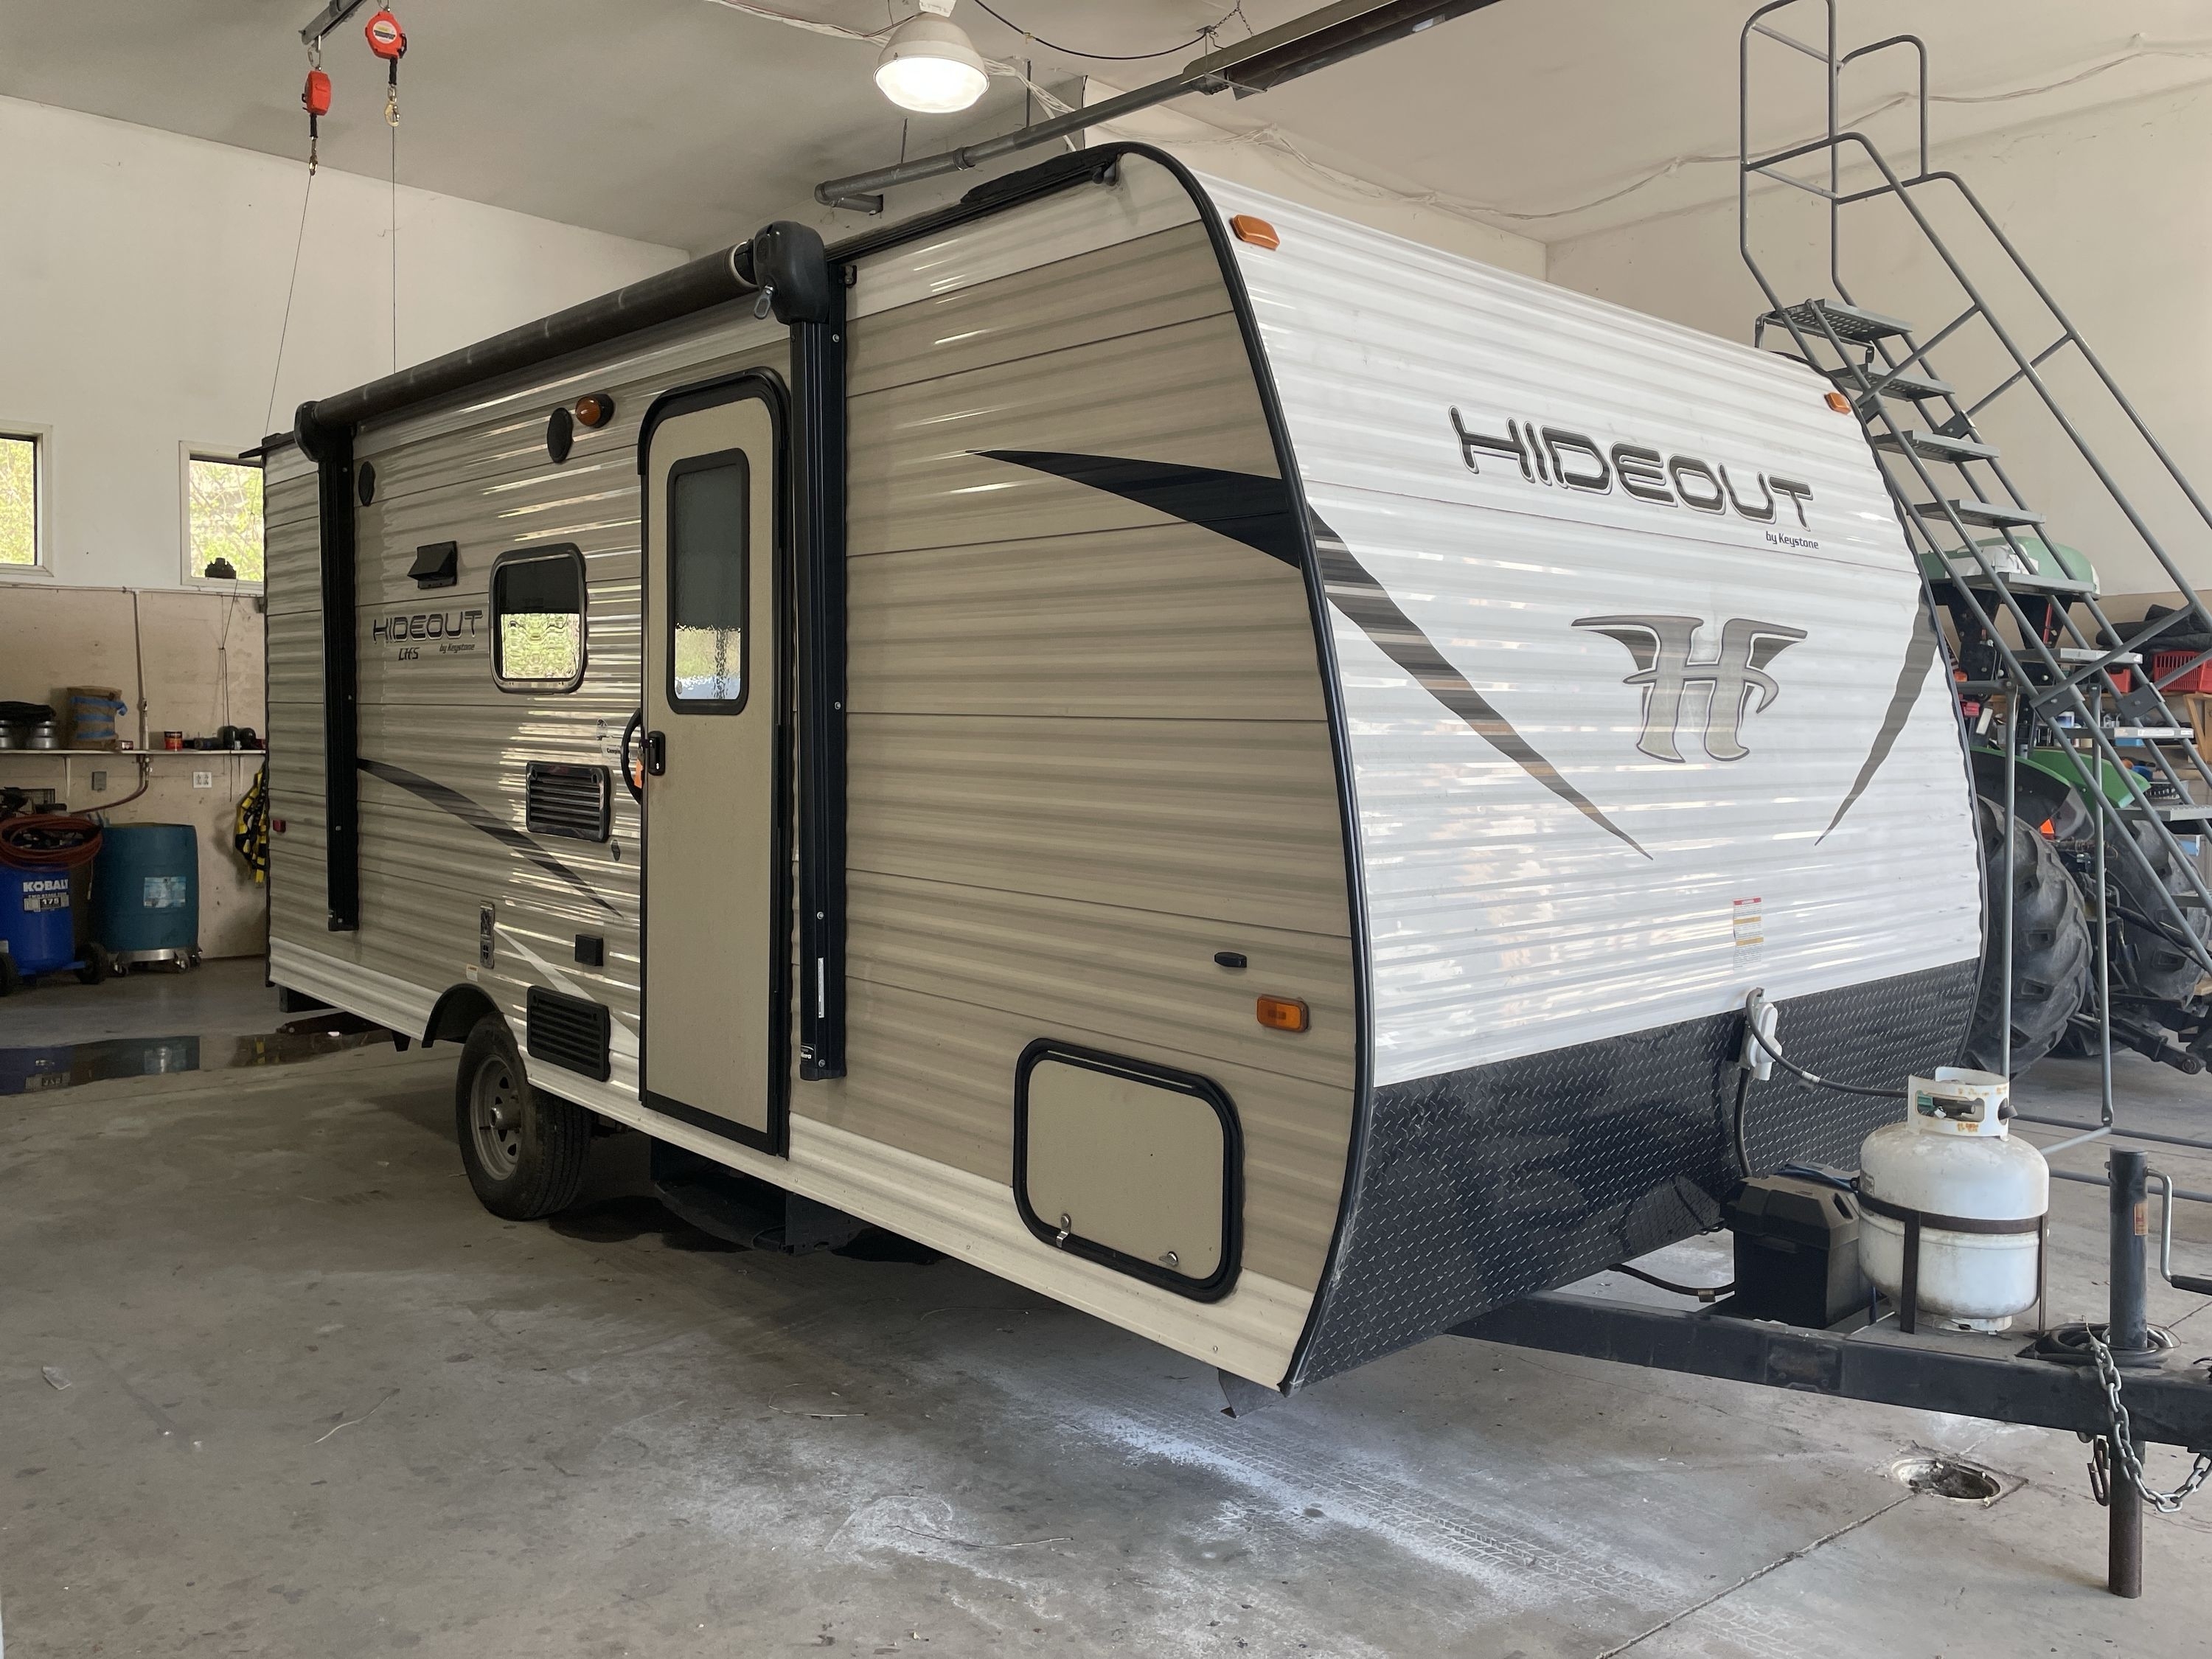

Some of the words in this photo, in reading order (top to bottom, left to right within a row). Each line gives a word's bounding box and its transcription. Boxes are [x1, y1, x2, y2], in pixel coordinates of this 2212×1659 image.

[1448, 405, 1813, 531] HIDEOUT
[1766, 530, 1778, 545] by
[1778, 532, 1819, 549] Keystone
[373, 610, 483, 644] HIDEOUT
[439, 644, 448, 653] by
[448, 643, 475, 654] Keystone
